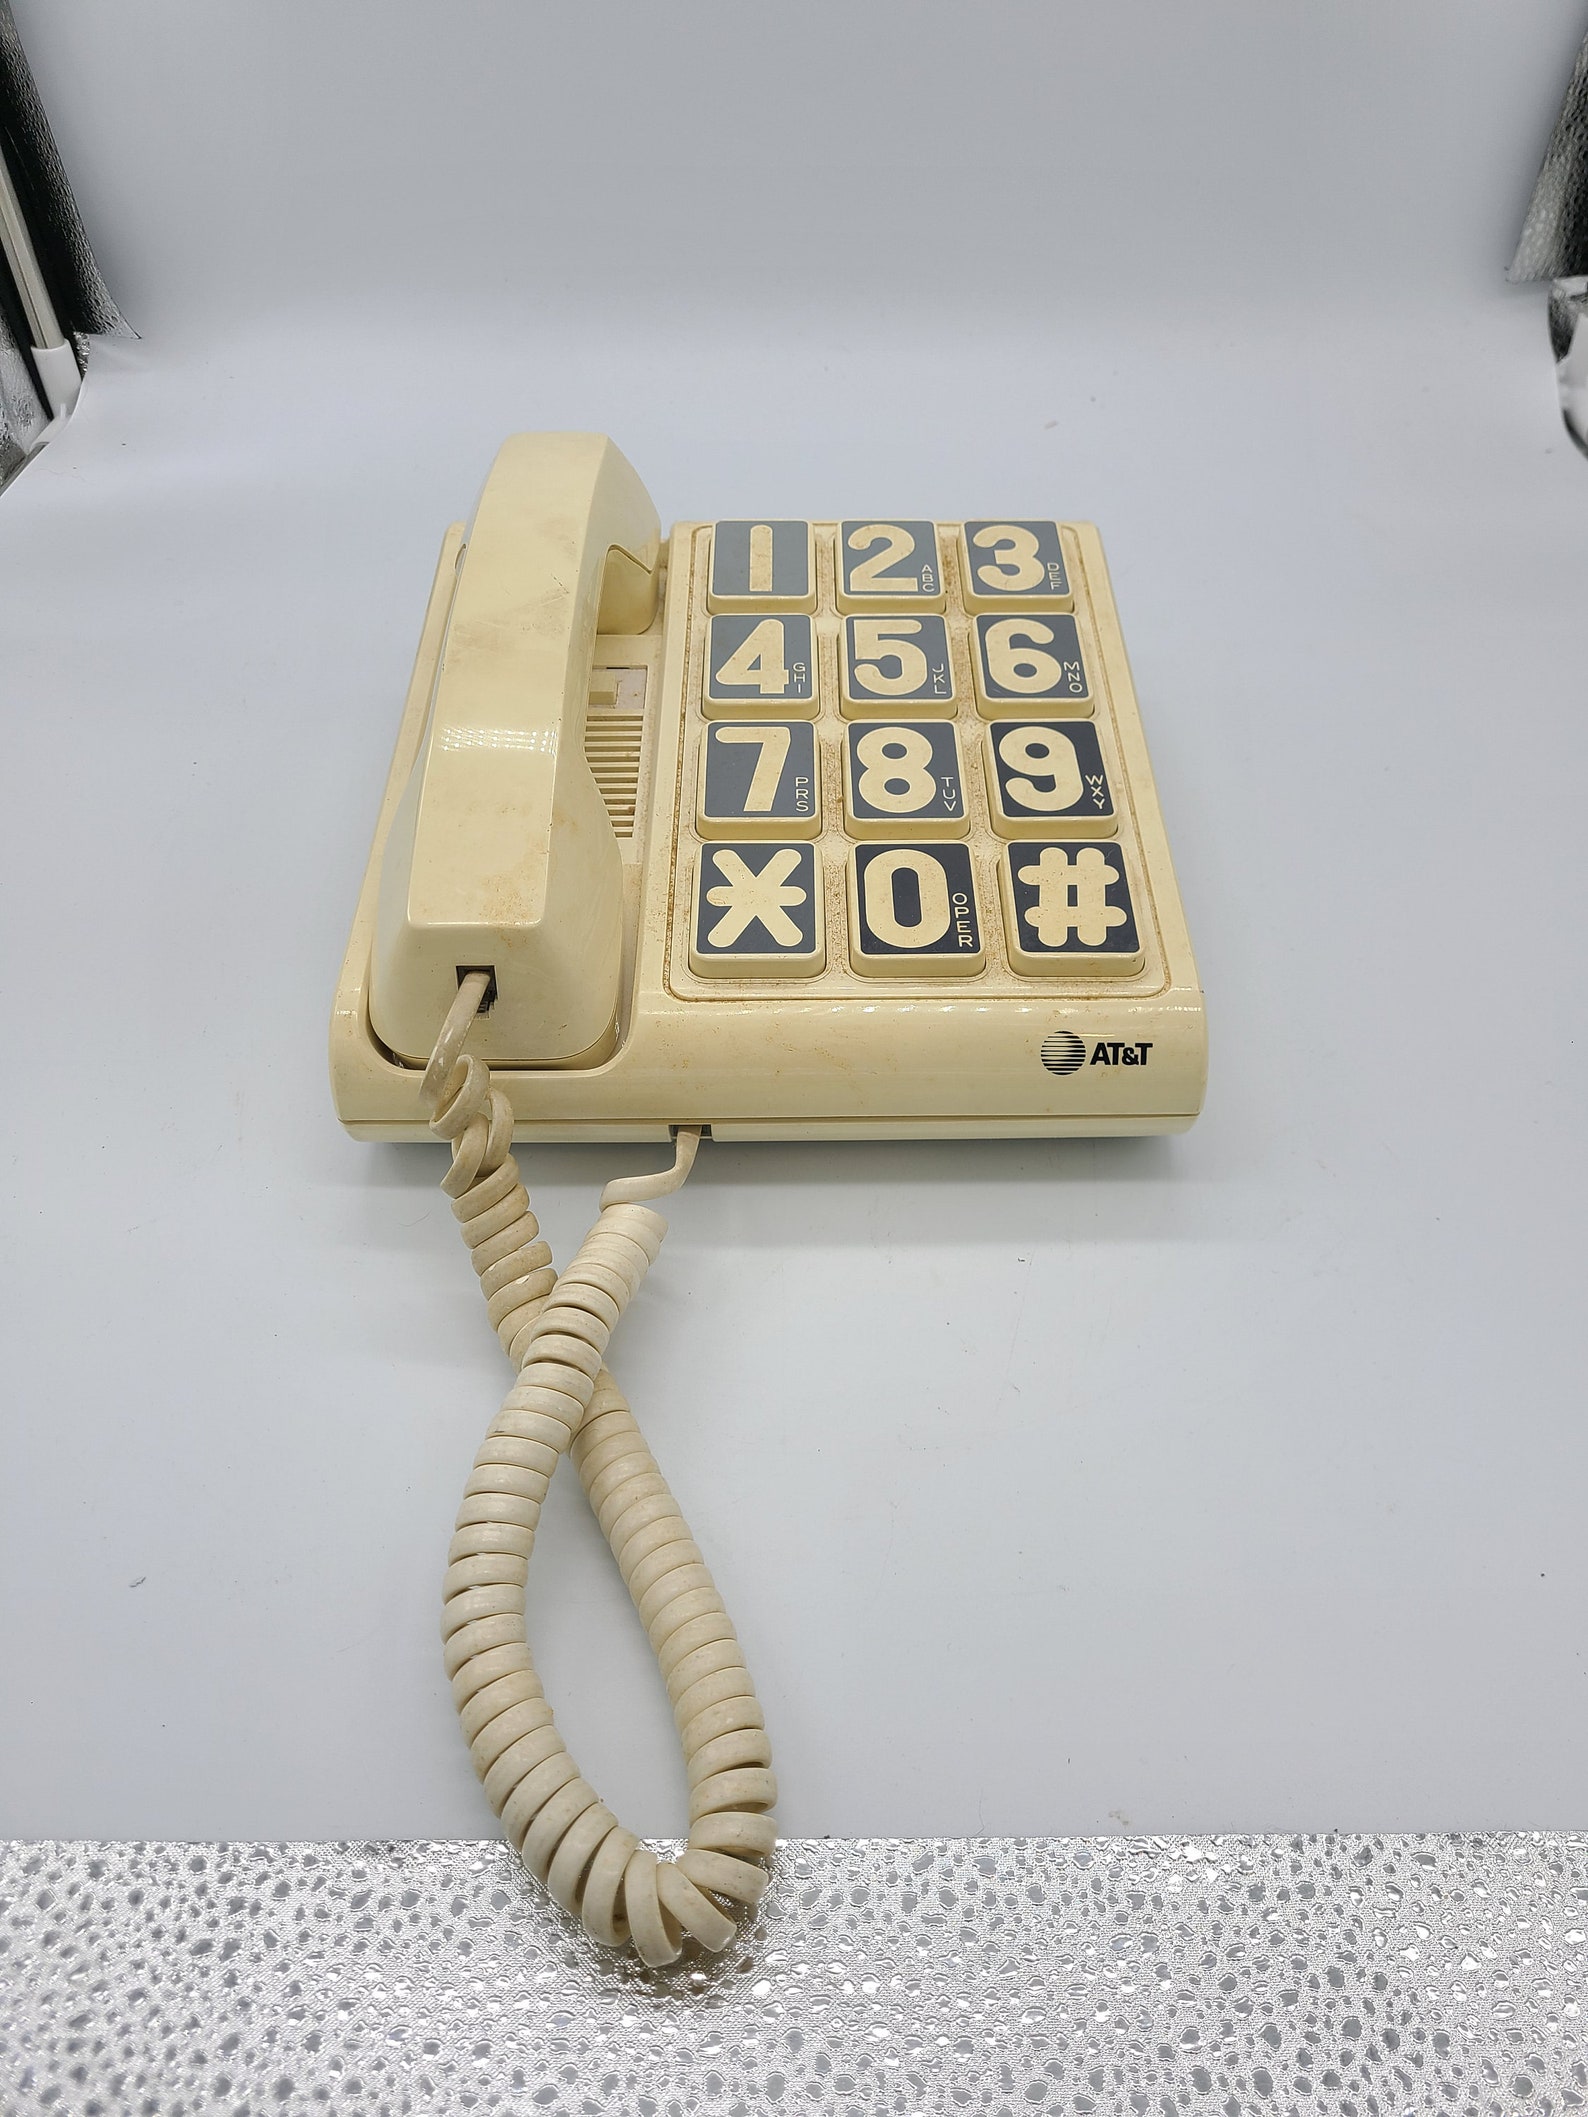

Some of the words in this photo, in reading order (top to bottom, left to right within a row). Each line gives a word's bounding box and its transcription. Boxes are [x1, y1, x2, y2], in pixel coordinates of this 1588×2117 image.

[847, 524, 919, 592] 2
[921, 564, 936, 592] ABC
[972, 524, 1046, 592] 3
[1046, 562, 1062, 591] DEF
[715, 618, 790, 695] 4
[853, 618, 928, 696] 5
[931, 663, 947, 695] JKL
[984, 618, 1062, 694] 6
[1063, 661, 1083, 693] MNO
[714, 726, 792, 812] 7
[794, 776, 809, 813] PRS
[856, 726, 937, 814] 8
[940, 776, 957, 813] TUV
[998, 725, 1084, 813] 9
[1084, 774, 1106, 810] WXY
[863, 848, 950, 949] 0
[952, 892, 973, 948] OPER
[1089, 1042, 1153, 1066] AT&T
